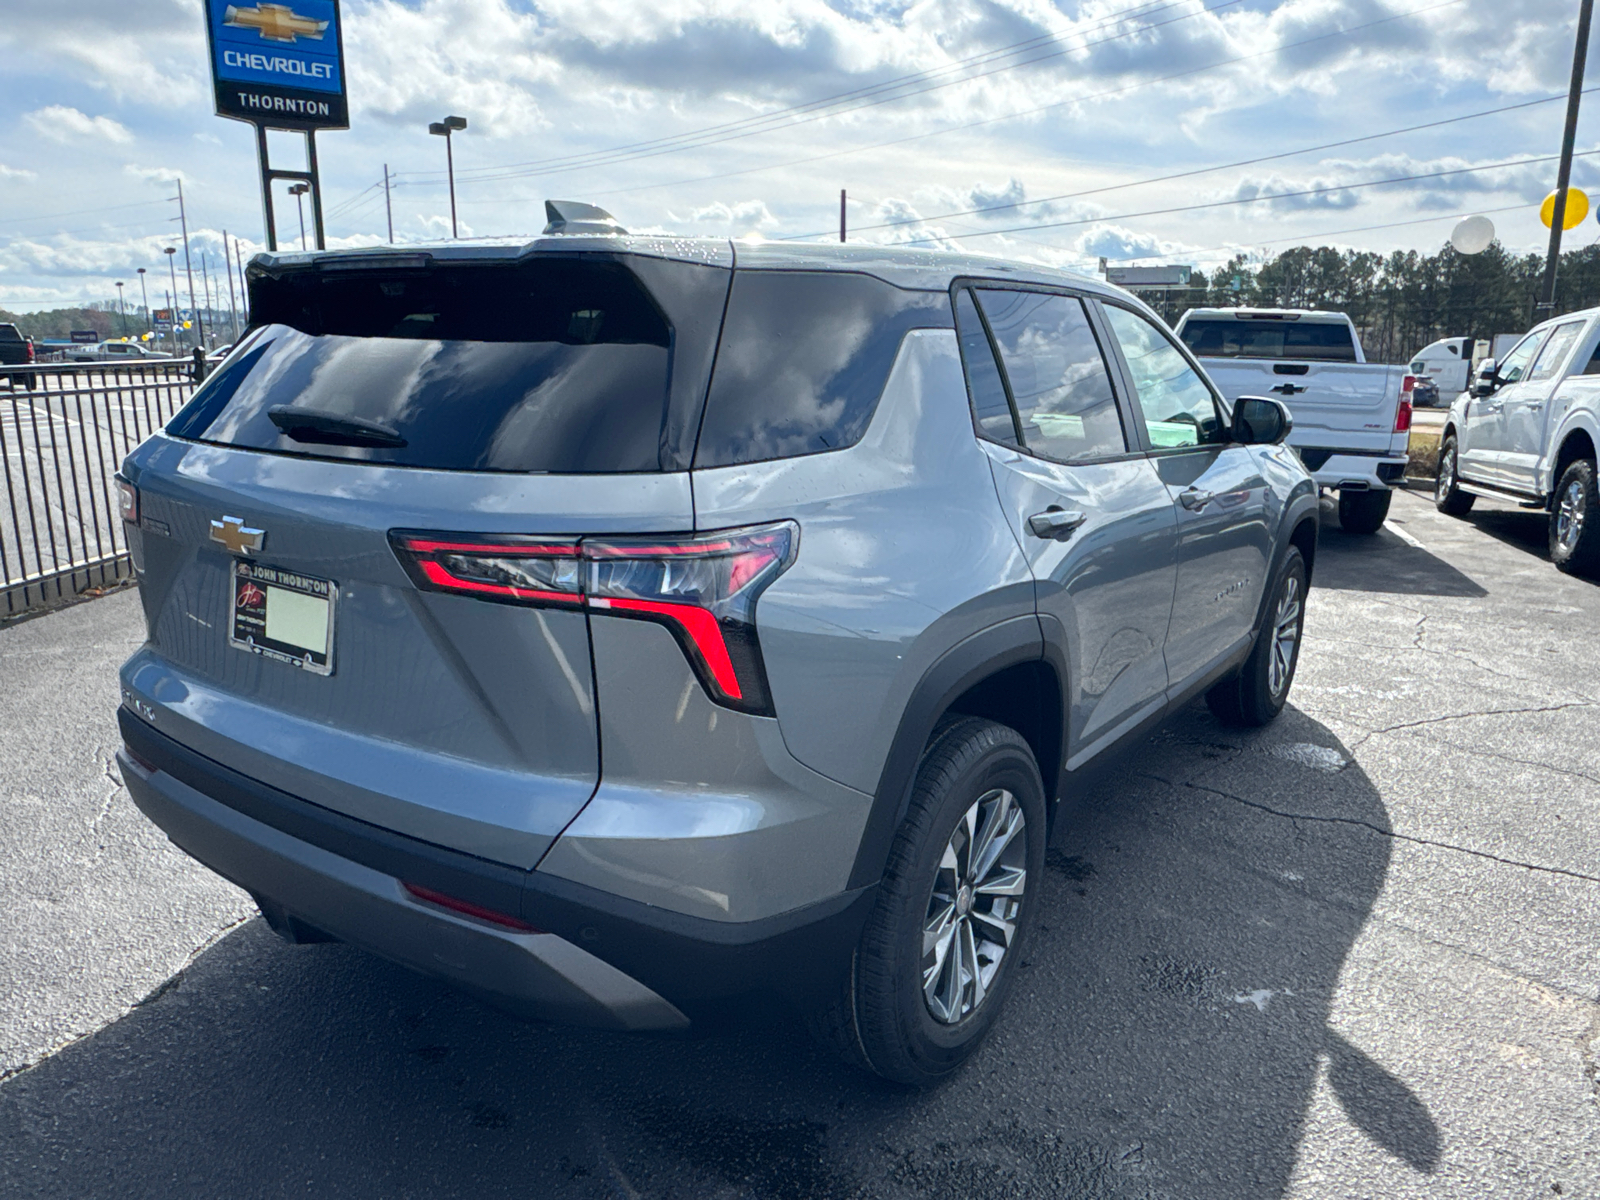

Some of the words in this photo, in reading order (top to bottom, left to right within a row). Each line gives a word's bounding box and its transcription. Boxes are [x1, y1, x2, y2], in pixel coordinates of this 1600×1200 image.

[224, 50, 333, 79] CHEVROLET
[238, 92, 330, 116] THORNTON
[253, 566, 277, 581] JOHN
